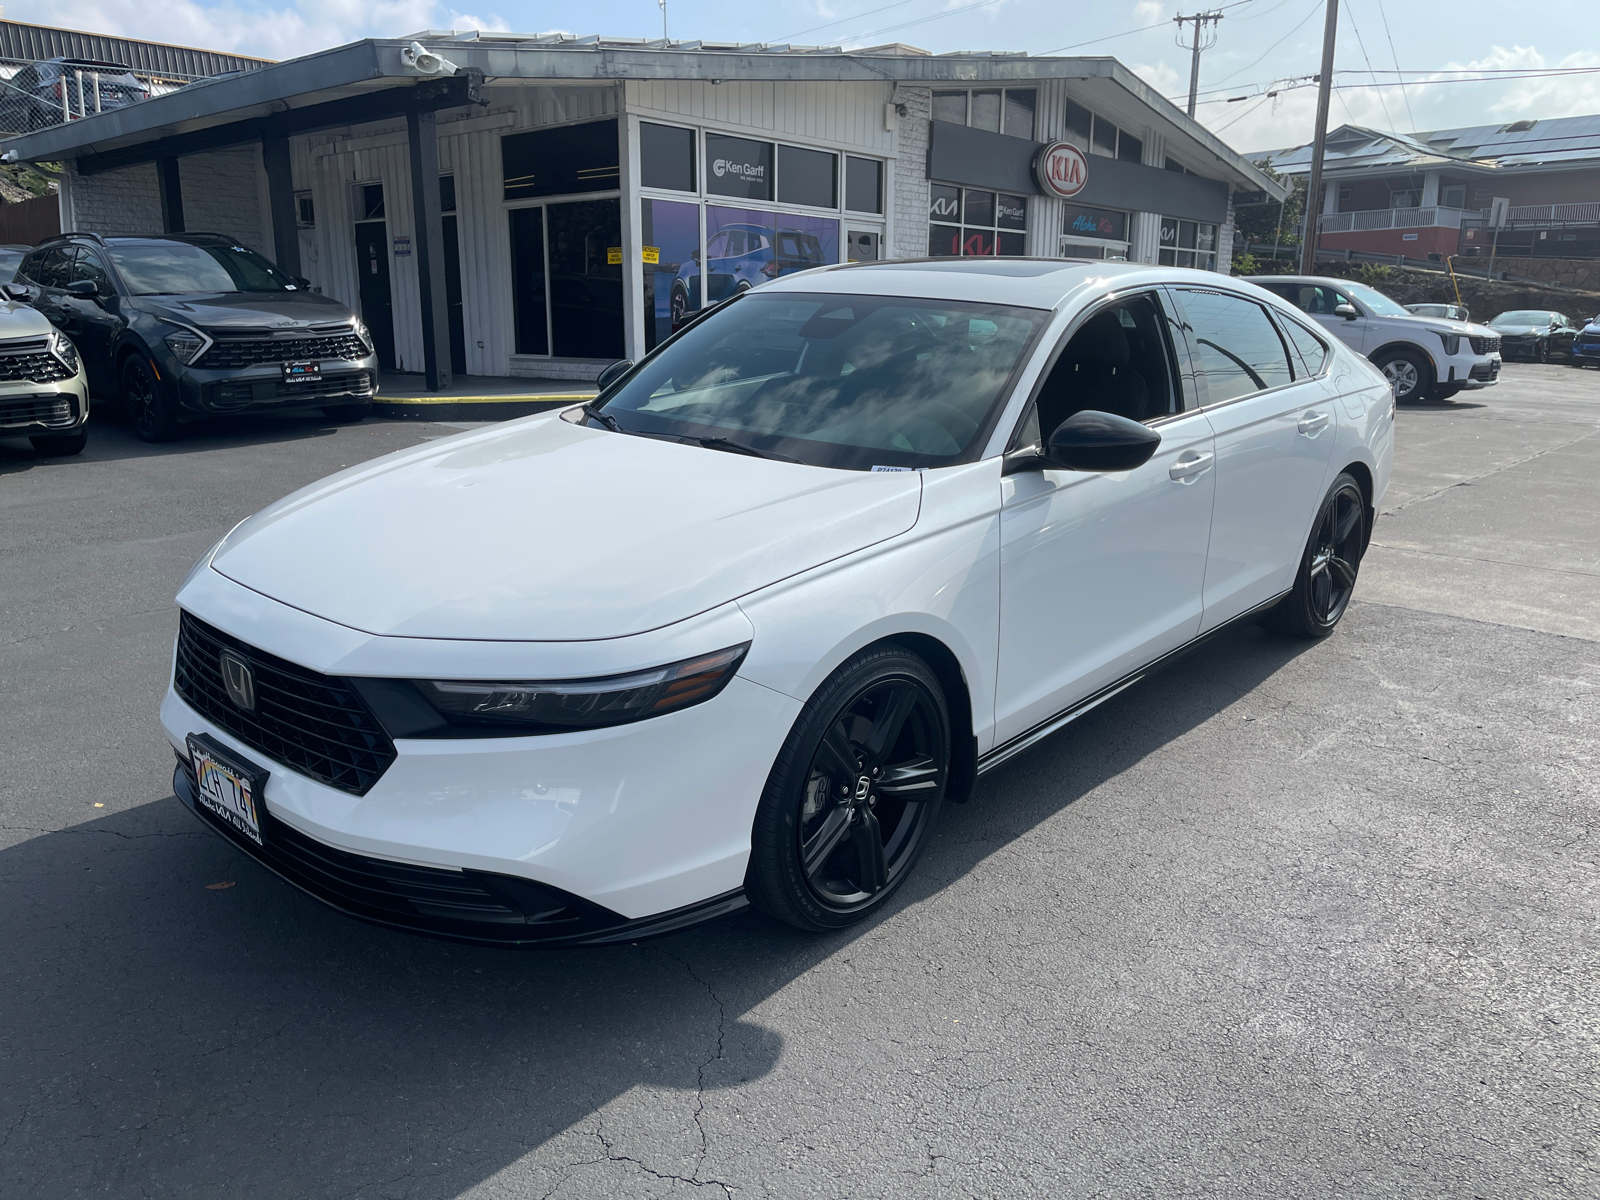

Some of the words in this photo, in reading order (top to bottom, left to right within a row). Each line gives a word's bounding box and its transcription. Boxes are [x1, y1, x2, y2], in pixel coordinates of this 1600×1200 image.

[726, 160, 742, 174] Ken
[743, 163, 764, 177] Garff
[1052, 155, 1081, 184] KIA
[1003, 206, 1013, 214] Ken
[1072, 215, 1097, 231] Aloha
[1097, 217, 1114, 233] Kia
[194, 754, 225, 803] ZLH
[199, 793, 216, 811] Aloha
[232, 816, 242, 830] All
